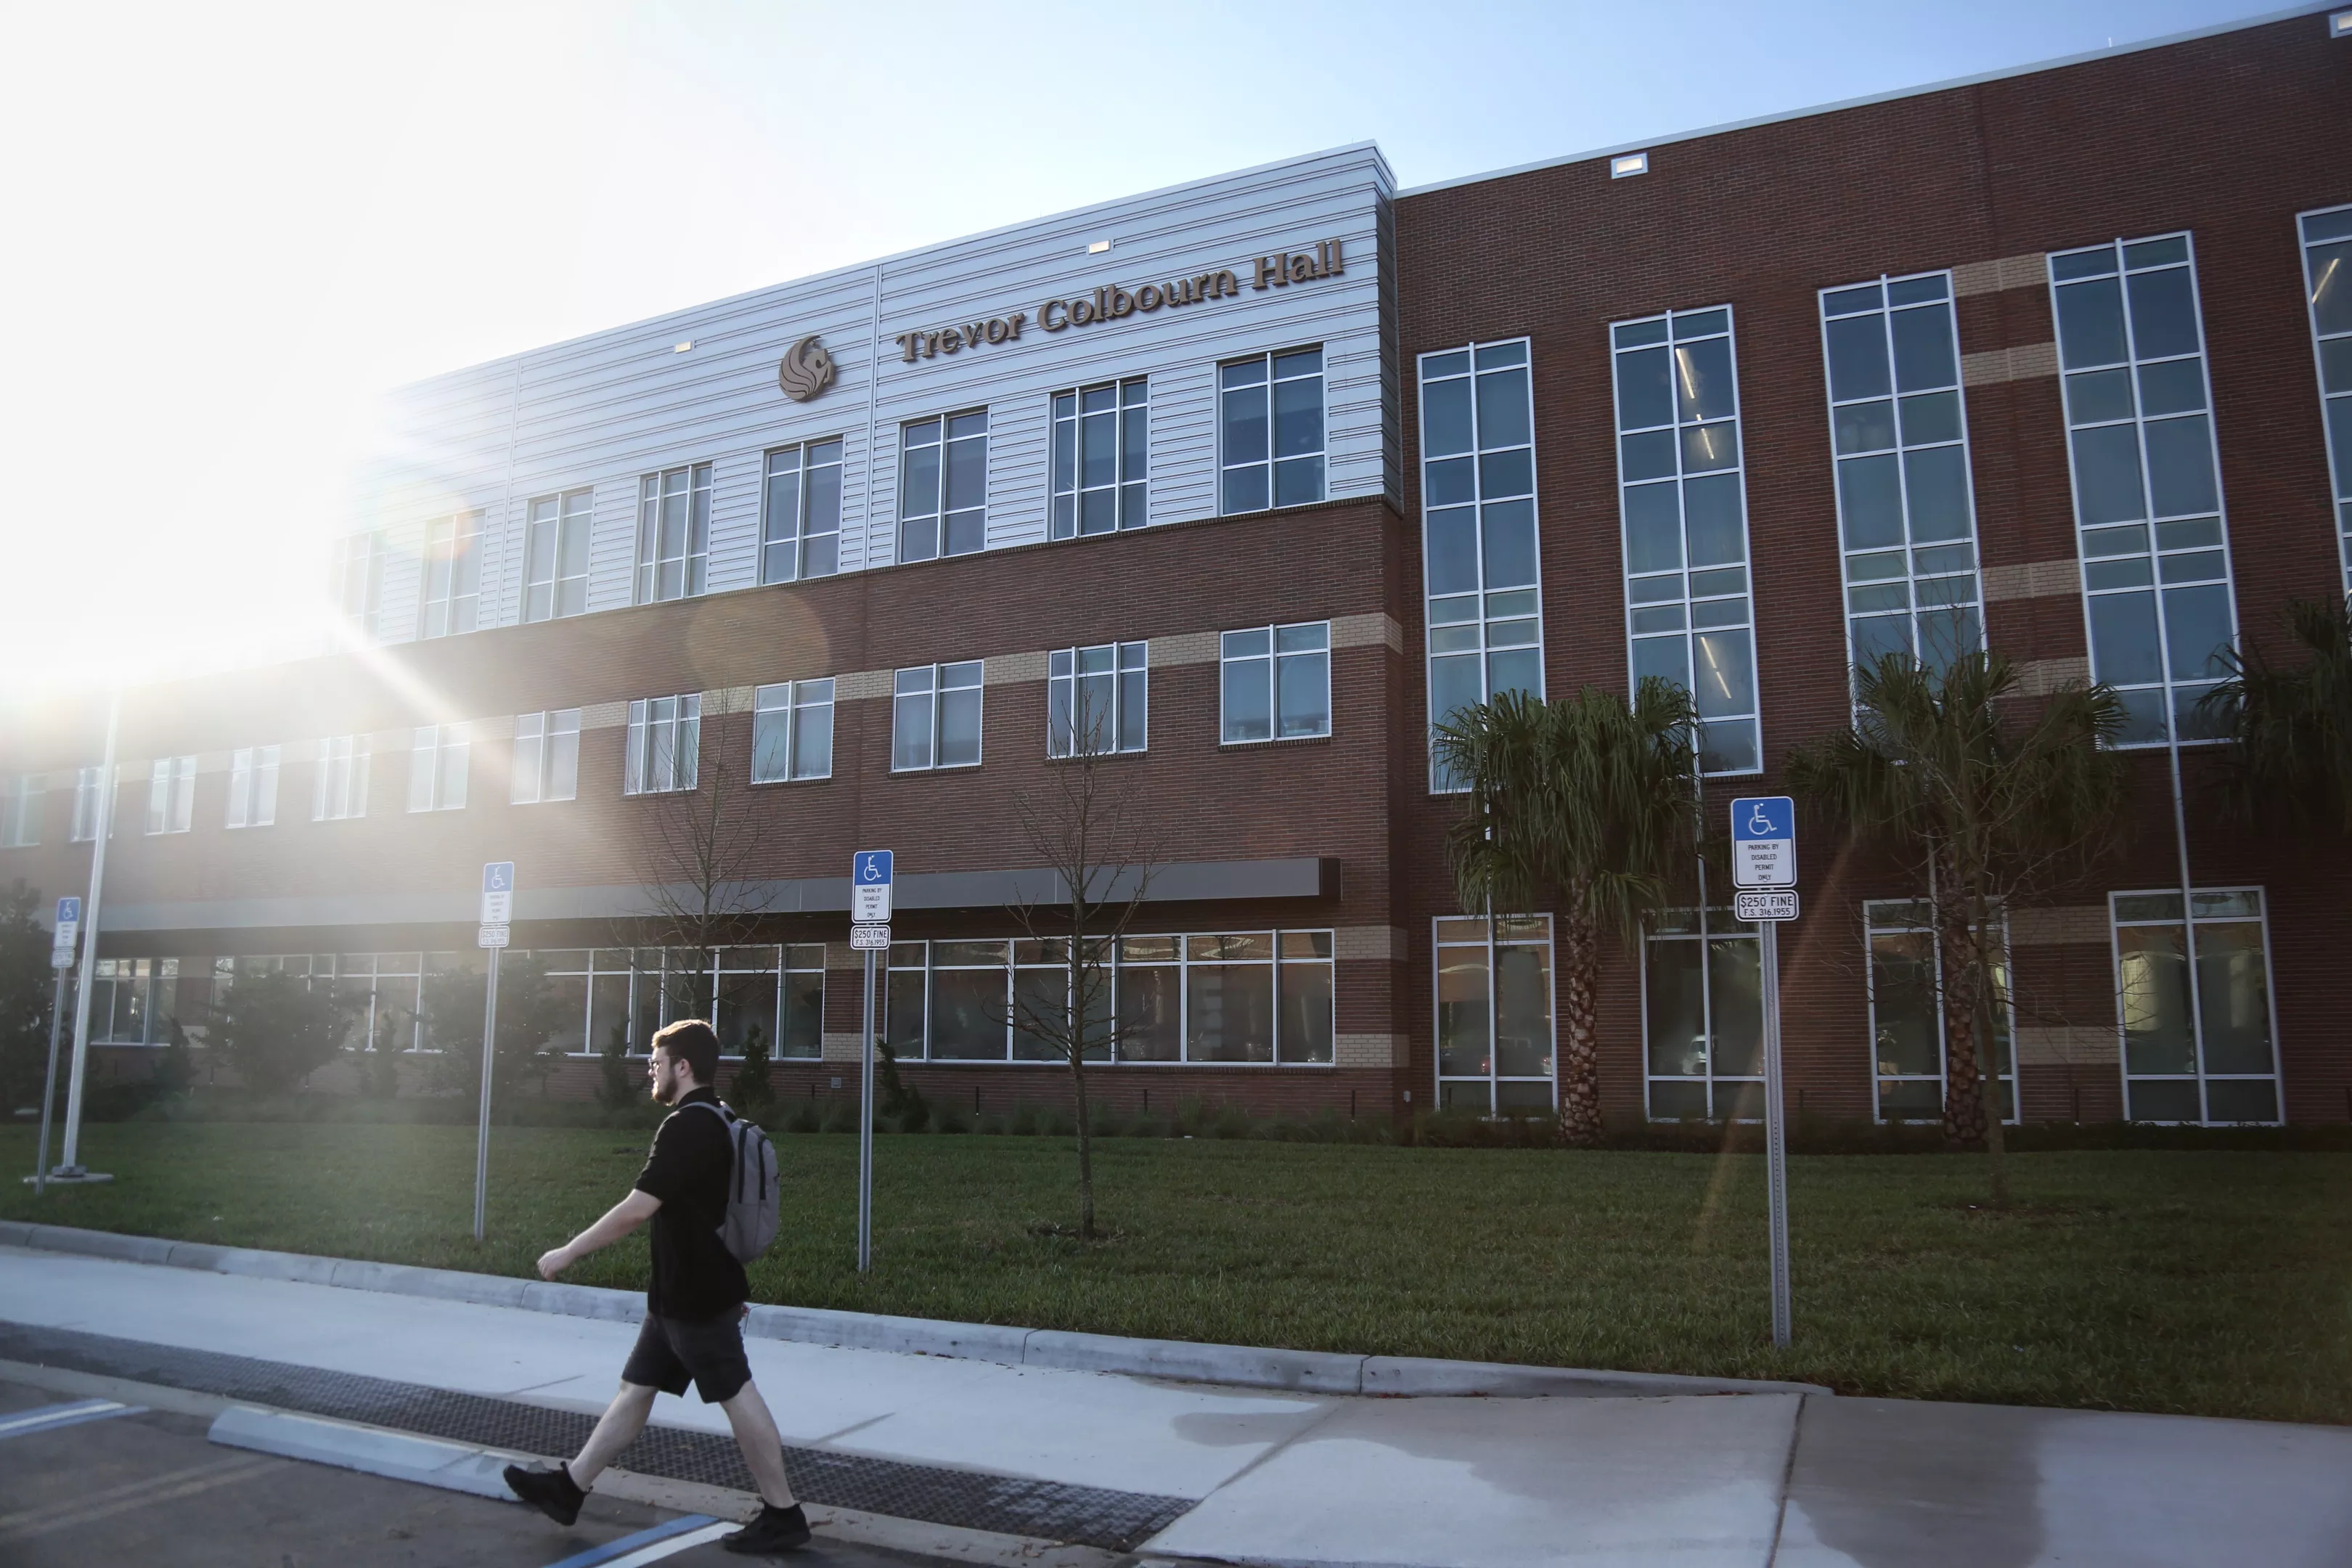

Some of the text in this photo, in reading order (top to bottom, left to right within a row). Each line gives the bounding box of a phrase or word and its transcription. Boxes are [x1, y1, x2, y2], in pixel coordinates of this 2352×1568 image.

[897, 237, 1345, 363] Trevor Colbourn Hall
[1740, 896, 1794, 908] $250 FINE
[1759, 908, 1791, 917] 316.1955
[854, 930, 887, 939] $250 FINE
